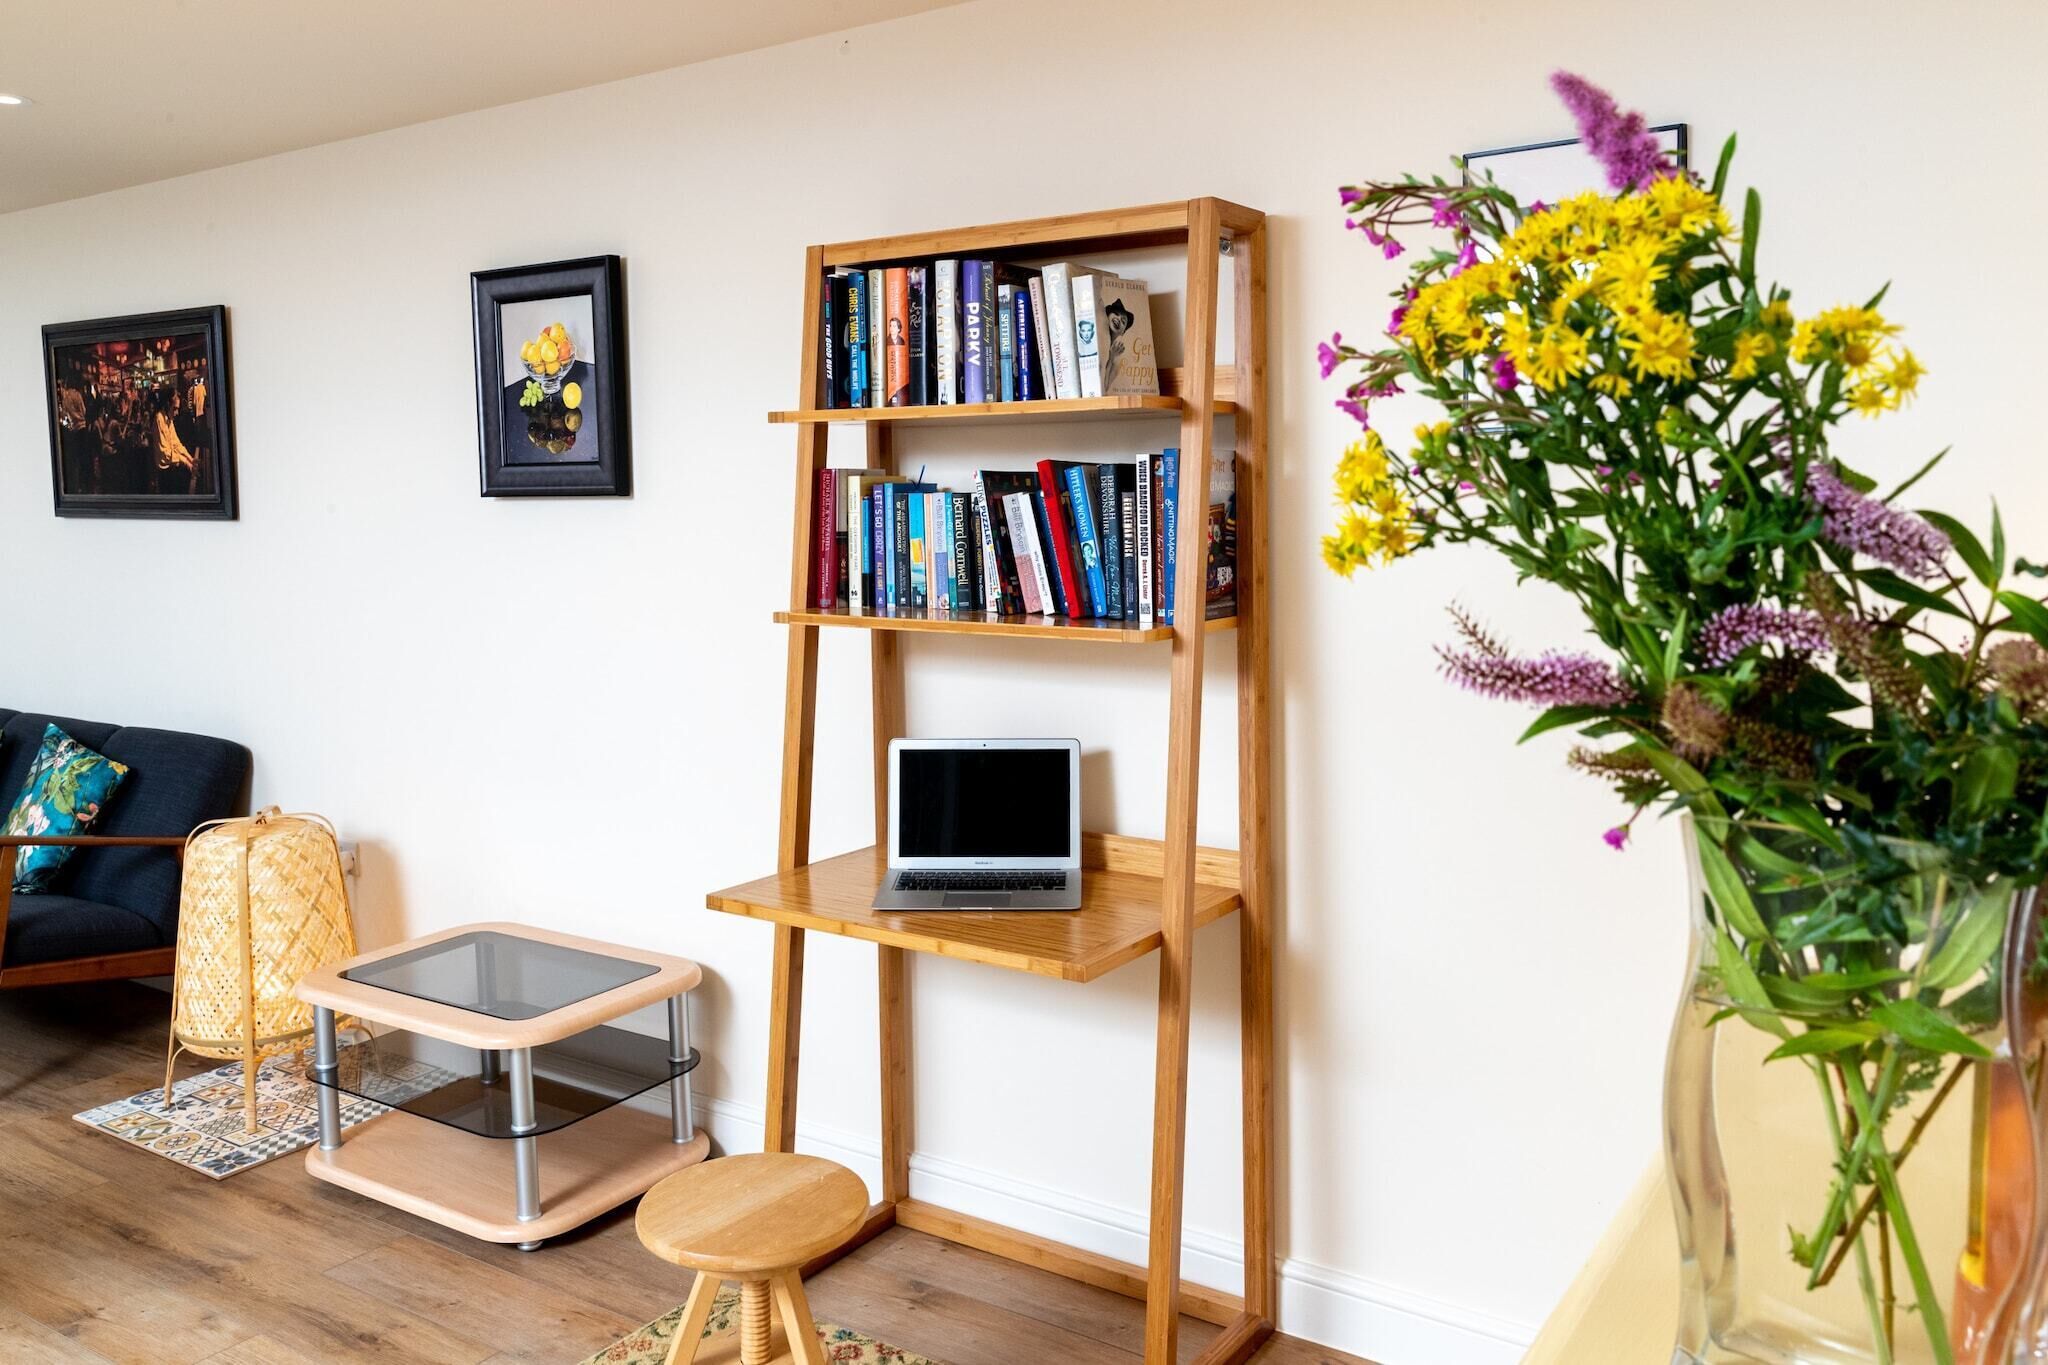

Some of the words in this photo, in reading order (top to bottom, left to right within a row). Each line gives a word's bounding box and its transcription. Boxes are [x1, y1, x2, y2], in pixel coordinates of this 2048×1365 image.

[848, 287, 859, 313] CHRIS
[983, 273, 993, 301] Portrait
[983, 302, 992, 310] of
[849, 315, 860, 344] EVANS
[937, 288, 952, 381] CLAPTON
[966, 302, 980, 366] PARKY
[983, 312, 993, 344] Johnny
[1001, 313, 1010, 352] SPITFIRE
[1054, 342, 1064, 388] TOWNSEND
[1133, 337, 1153, 363] Get
[1138, 460, 1148, 484] WHEN
[1166, 456, 1175, 472] Harry
[1167, 472, 1176, 488] Potter
[874, 490, 883, 516] LET'S
[896, 501, 901, 510] OF
[1100, 475, 1110, 535] DEVONSHIRE
[1107, 475, 1116, 520] DEBORAH
[1138, 484, 1148, 525] BRADFORD
[875, 516, 883, 528] GO
[953, 497, 967, 539] Bernard
[980, 505, 992, 546] PUZZLES
[1011, 506, 1020, 522] Bill
[1076, 504, 1089, 538] WOMEN
[1124, 497, 1133, 538] GENTLEMAN
[875, 530, 884, 556] CRAZY
[1014, 522, 1026, 553] Bryson
[1124, 540, 1134, 558] JACK
[1140, 526, 1148, 557] ROCKED
[955, 538, 969, 586] Cornwell
